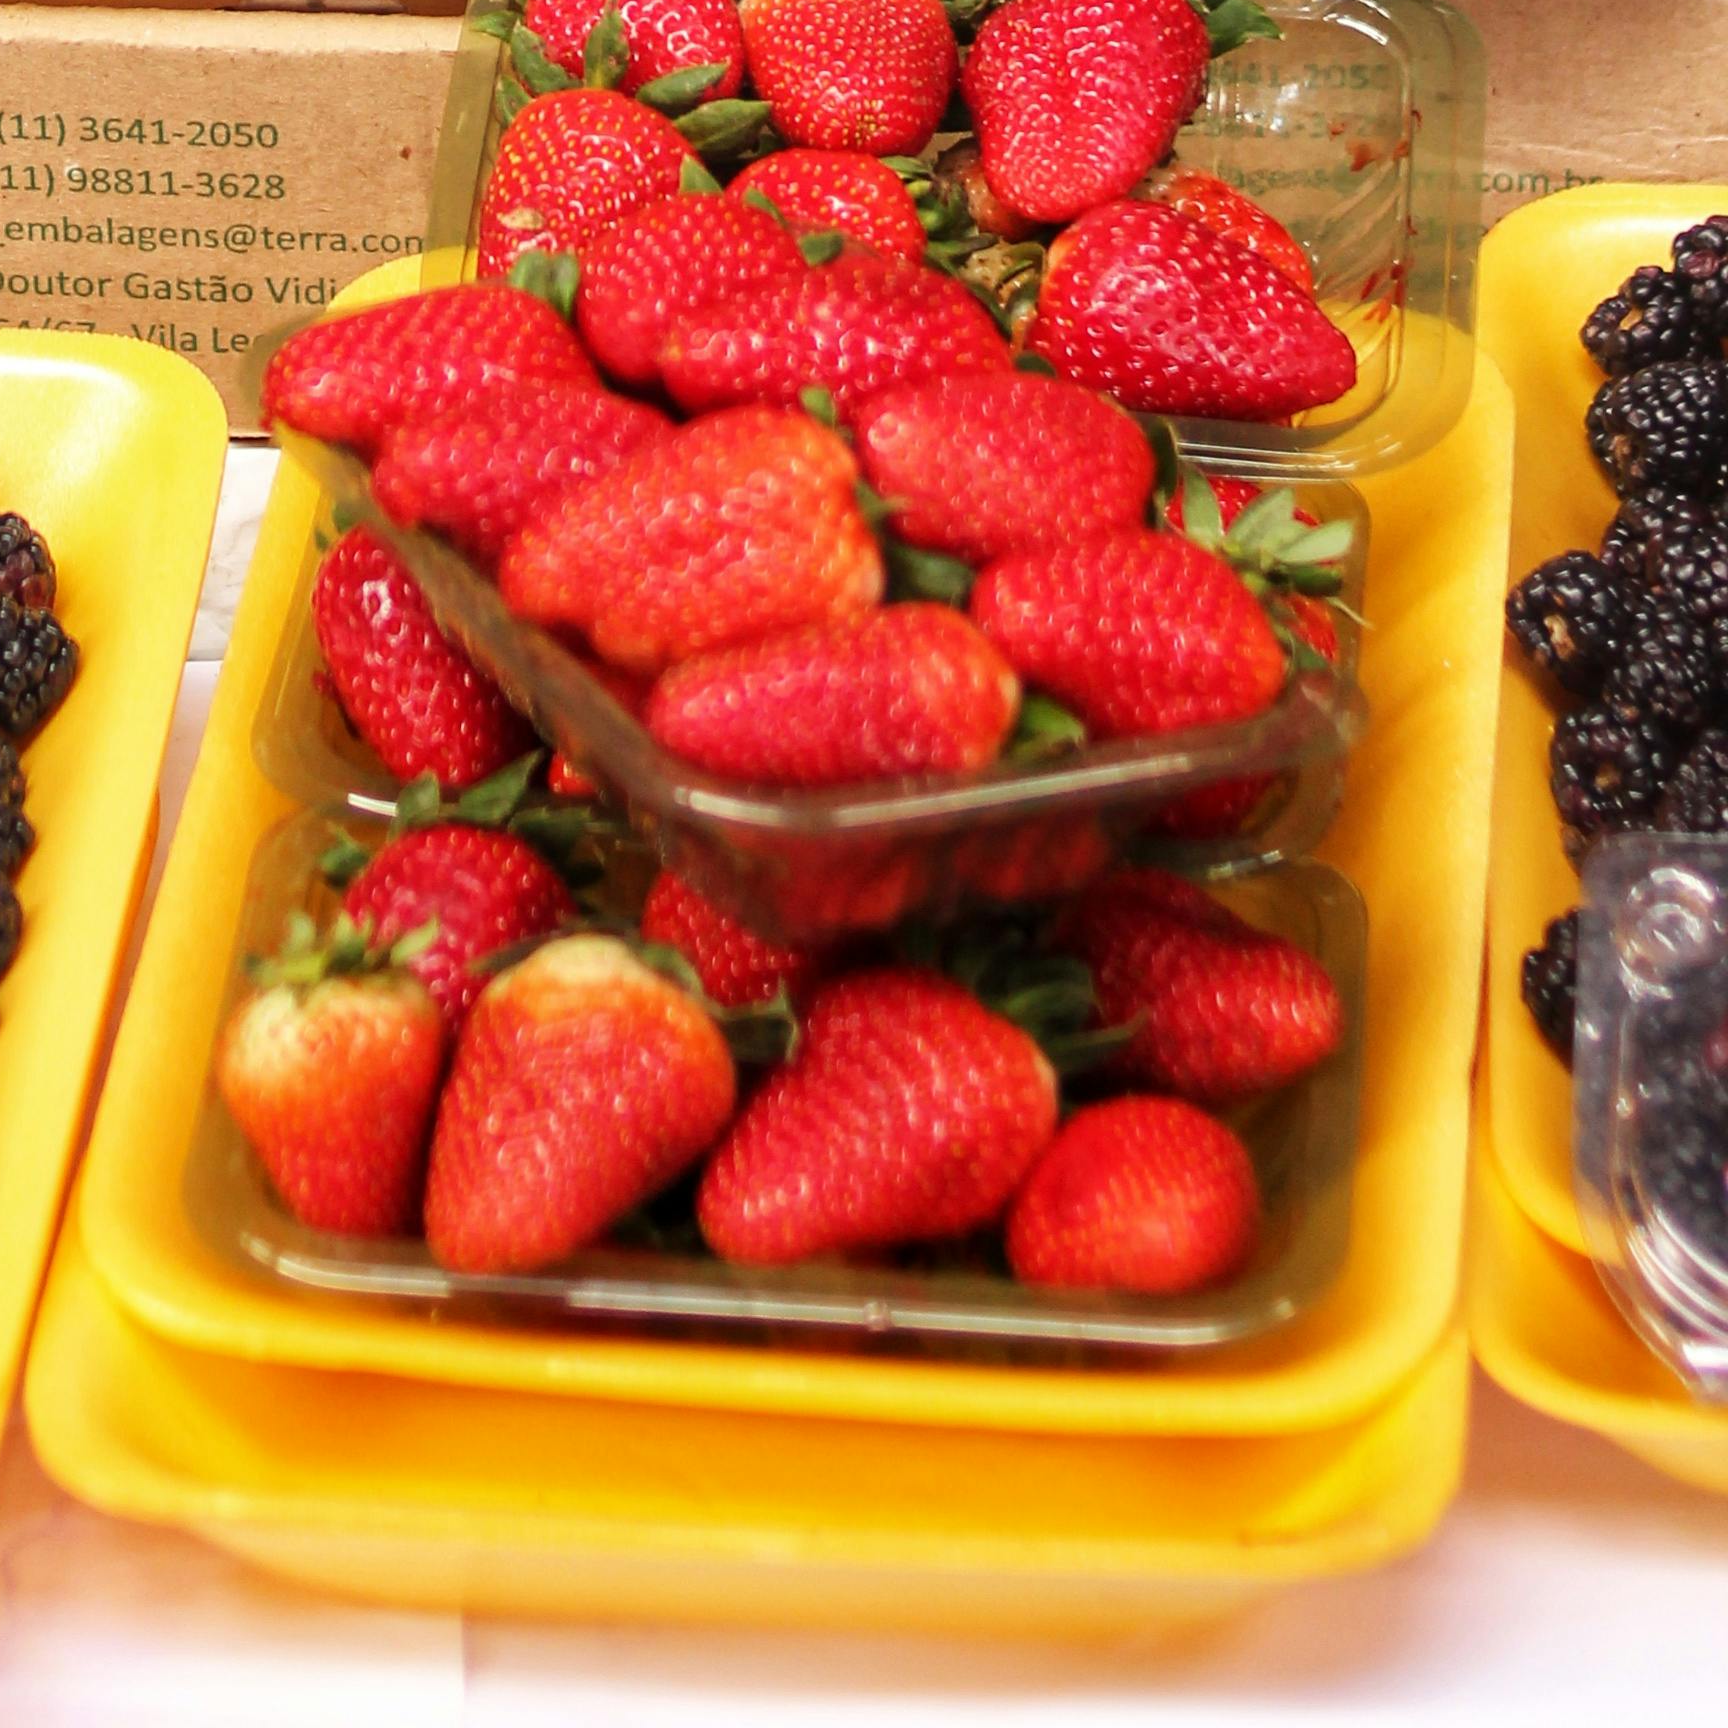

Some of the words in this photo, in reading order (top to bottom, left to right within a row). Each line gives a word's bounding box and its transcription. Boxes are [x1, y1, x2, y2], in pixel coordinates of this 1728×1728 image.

[79, 116, 279, 148] 3641-2050
[67, 167, 286, 200] 98811-3628
[124, 272, 253, 304] Gastão
[131, 323, 198, 353] Vila
